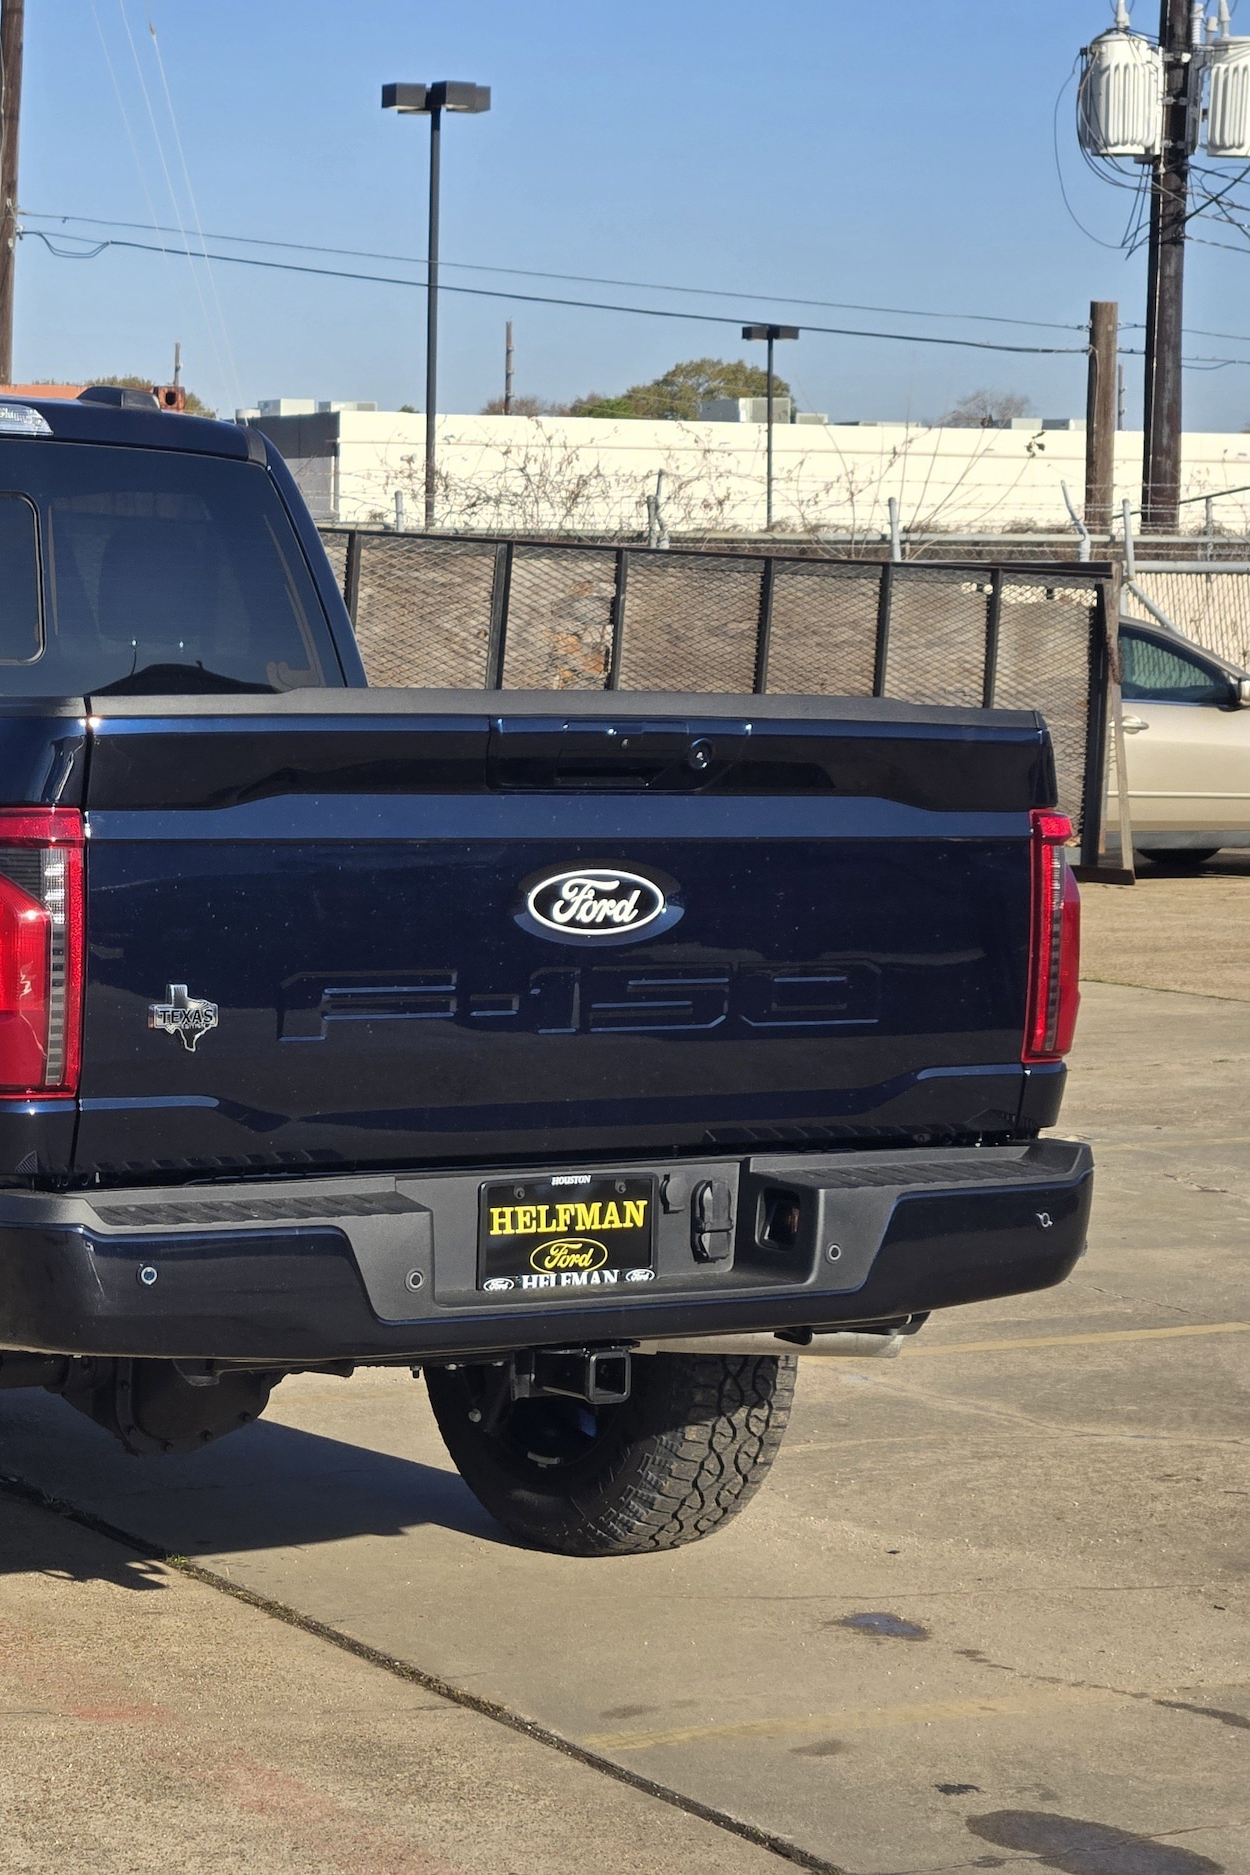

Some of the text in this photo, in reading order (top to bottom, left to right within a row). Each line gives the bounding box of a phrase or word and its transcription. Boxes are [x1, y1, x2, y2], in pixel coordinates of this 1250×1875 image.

[552, 878, 642, 923] Ford
[159, 1009, 213, 1024] TEXAS
[551, 1174, 592, 1186] HOUSTON
[489, 1200, 648, 1235] HELFMAN
[544, 1241, 594, 1269] Ford
